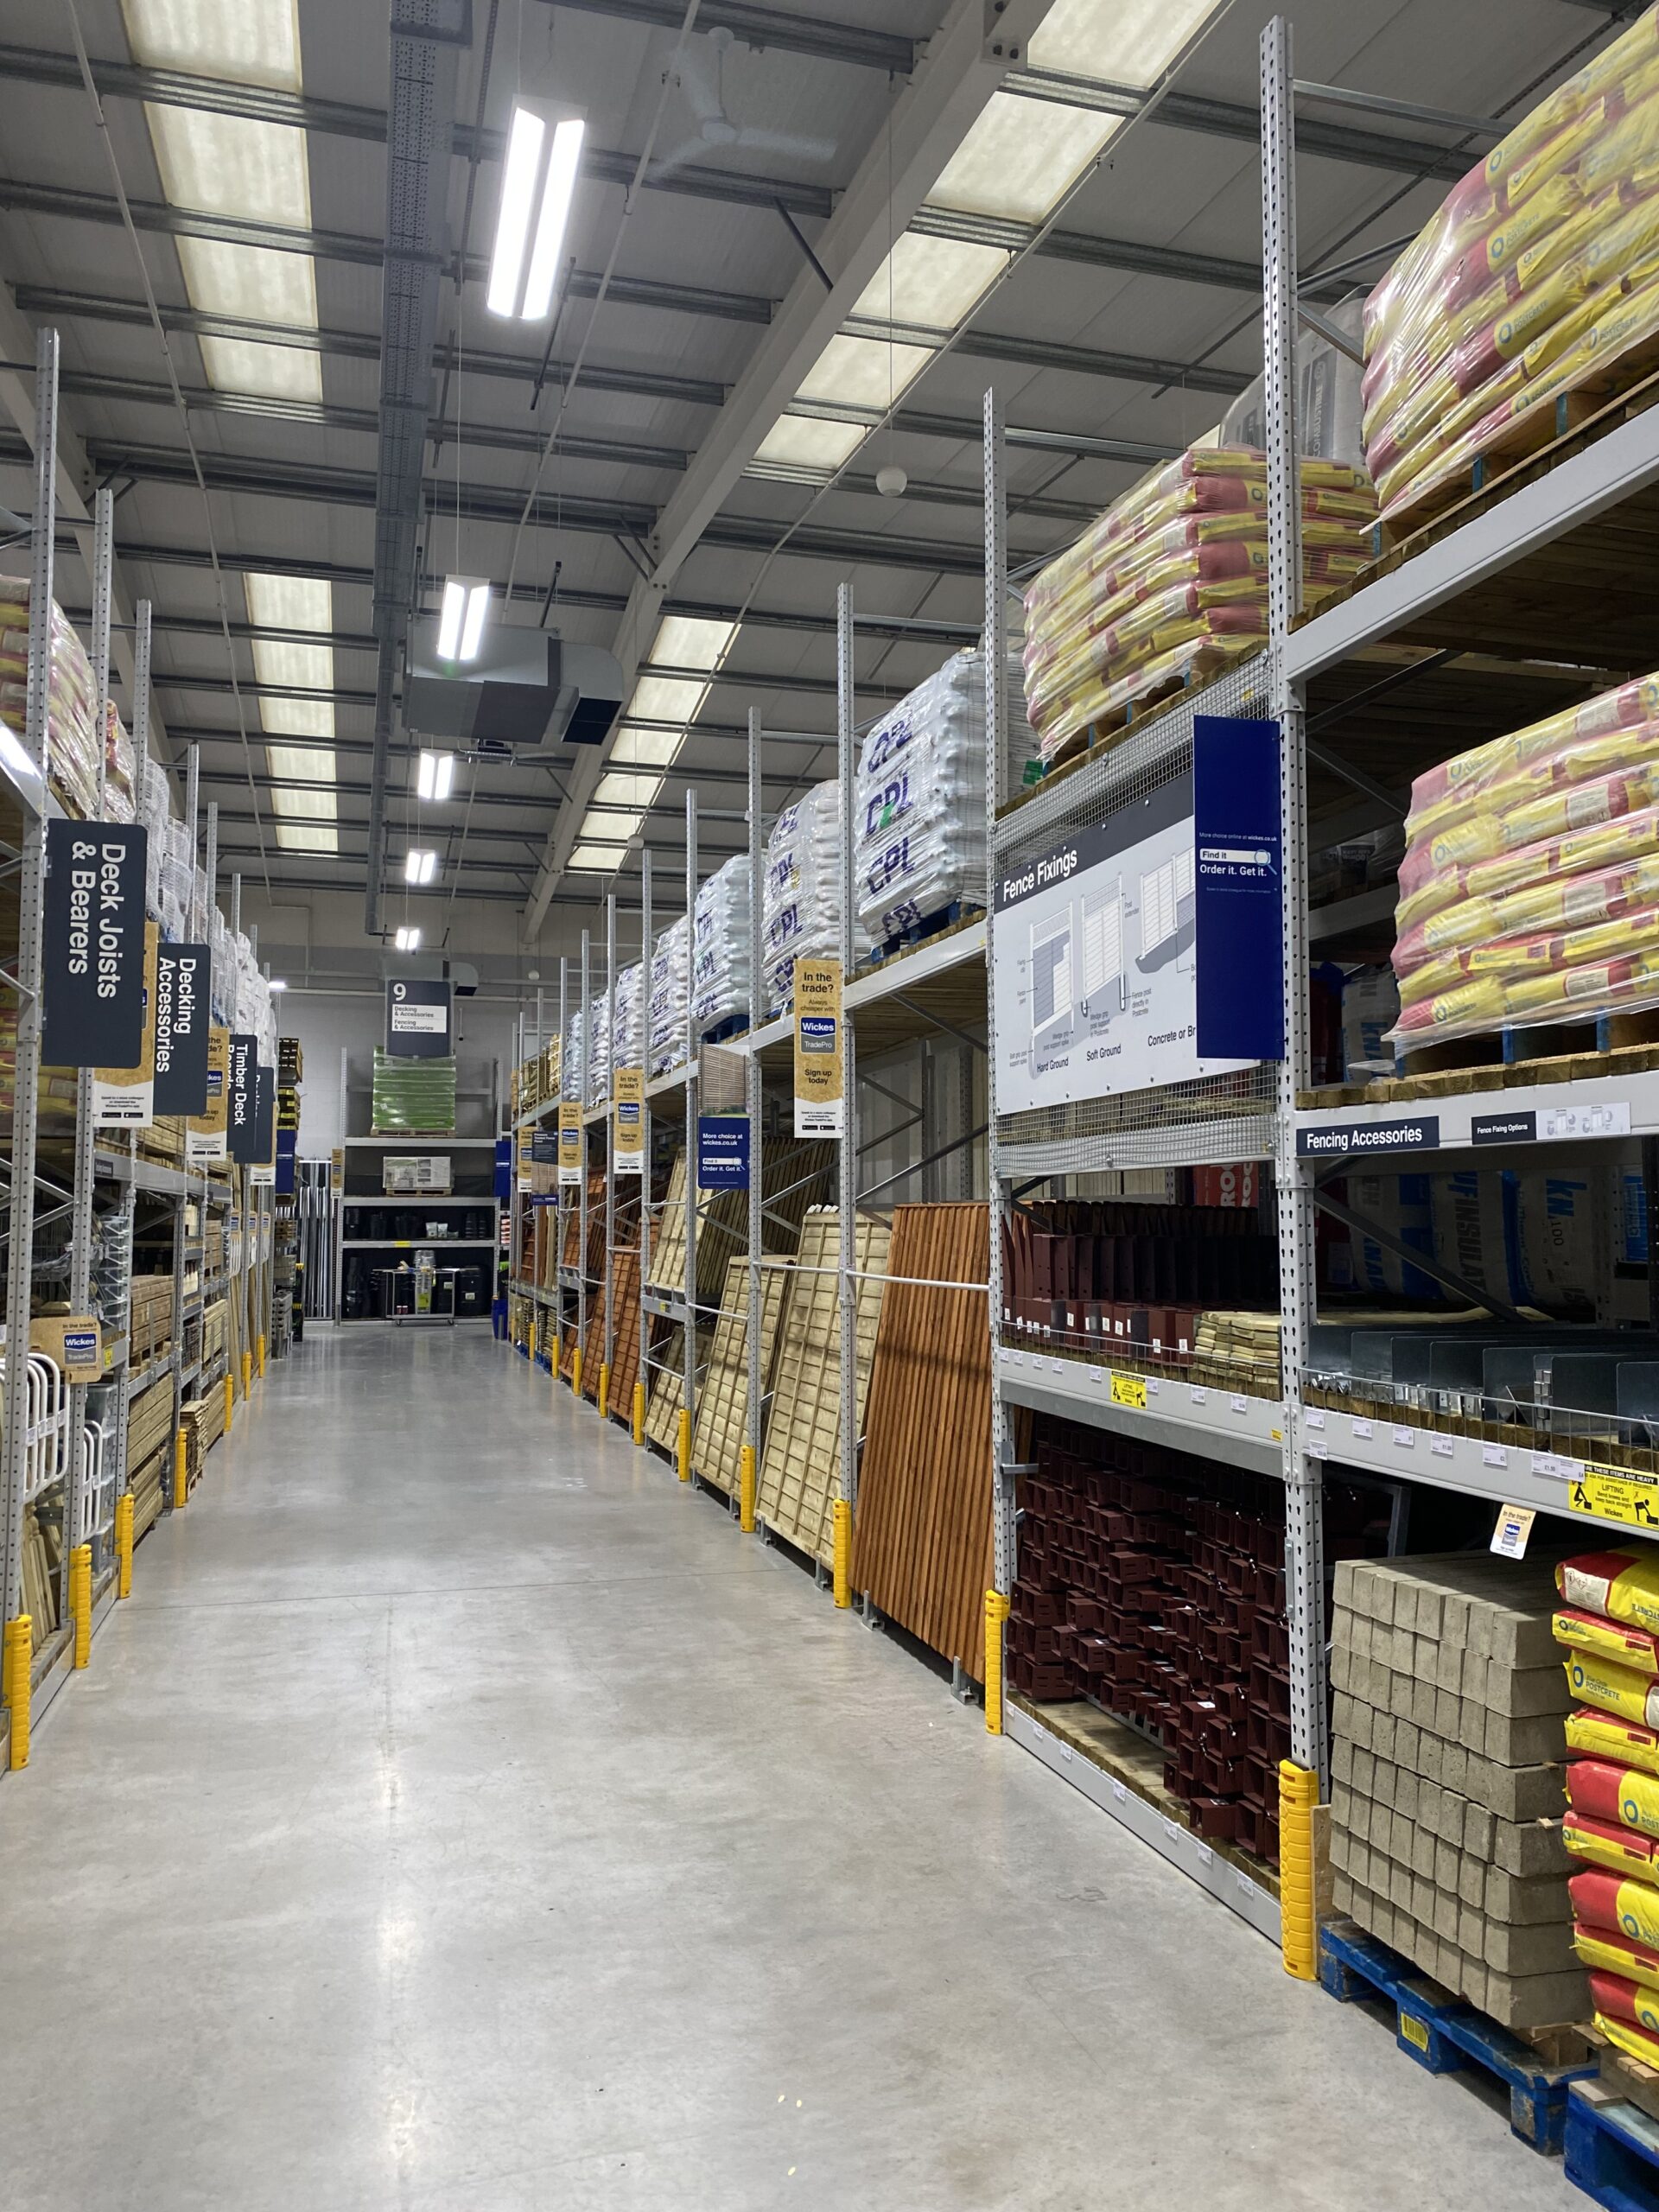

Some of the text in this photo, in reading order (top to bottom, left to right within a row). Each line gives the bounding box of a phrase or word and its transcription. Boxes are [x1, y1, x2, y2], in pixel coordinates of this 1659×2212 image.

[865, 772, 913, 838] CPL
[867, 836, 915, 895] CPL
[1199, 864, 1268, 877] Order it. Get it.
[1003, 849, 1078, 903] Fence Fixings
[68, 841, 97, 975] & Bearers
[97, 843, 126, 999] Deck Joists
[770, 903, 804, 947] CPL
[804, 972, 832, 982] In the
[173, 957, 197, 1035] Decking
[393, 982, 406, 1001] 9
[801, 984, 834, 993] trade?
[156, 957, 176, 1073] Accessories
[802, 1022, 835, 1032] Wickes
[804, 1040, 833, 1049] TradePro
[1147, 1029, 1177, 1046] Concrete
[1178, 1028, 1187, 1039] or
[1086, 1044, 1122, 1061] Soft Ground
[804, 1068, 822, 1077] Sign
[1037, 1057, 1069, 1072] Hard Ground
[234, 1044, 248, 1126] Timber Deck
[808, 1077, 829, 1085] today
[1306, 1124, 1423, 1151] Fencing Accessories
[1477, 1122, 1529, 1135] Fence Fixing Options
[1593, 1466, 1609, 1475] THESE
[1610, 1470, 1625, 1478] ITEMS
[1625, 1472, 1637, 1481] ARE
[1637, 1475, 1655, 1484] HEAVY
[1601, 1483, 1624, 1495] LIFTING
[1604, 1507, 1624, 1518] Wickes
[1585, 1681, 1621, 1701] POSTCRETE
